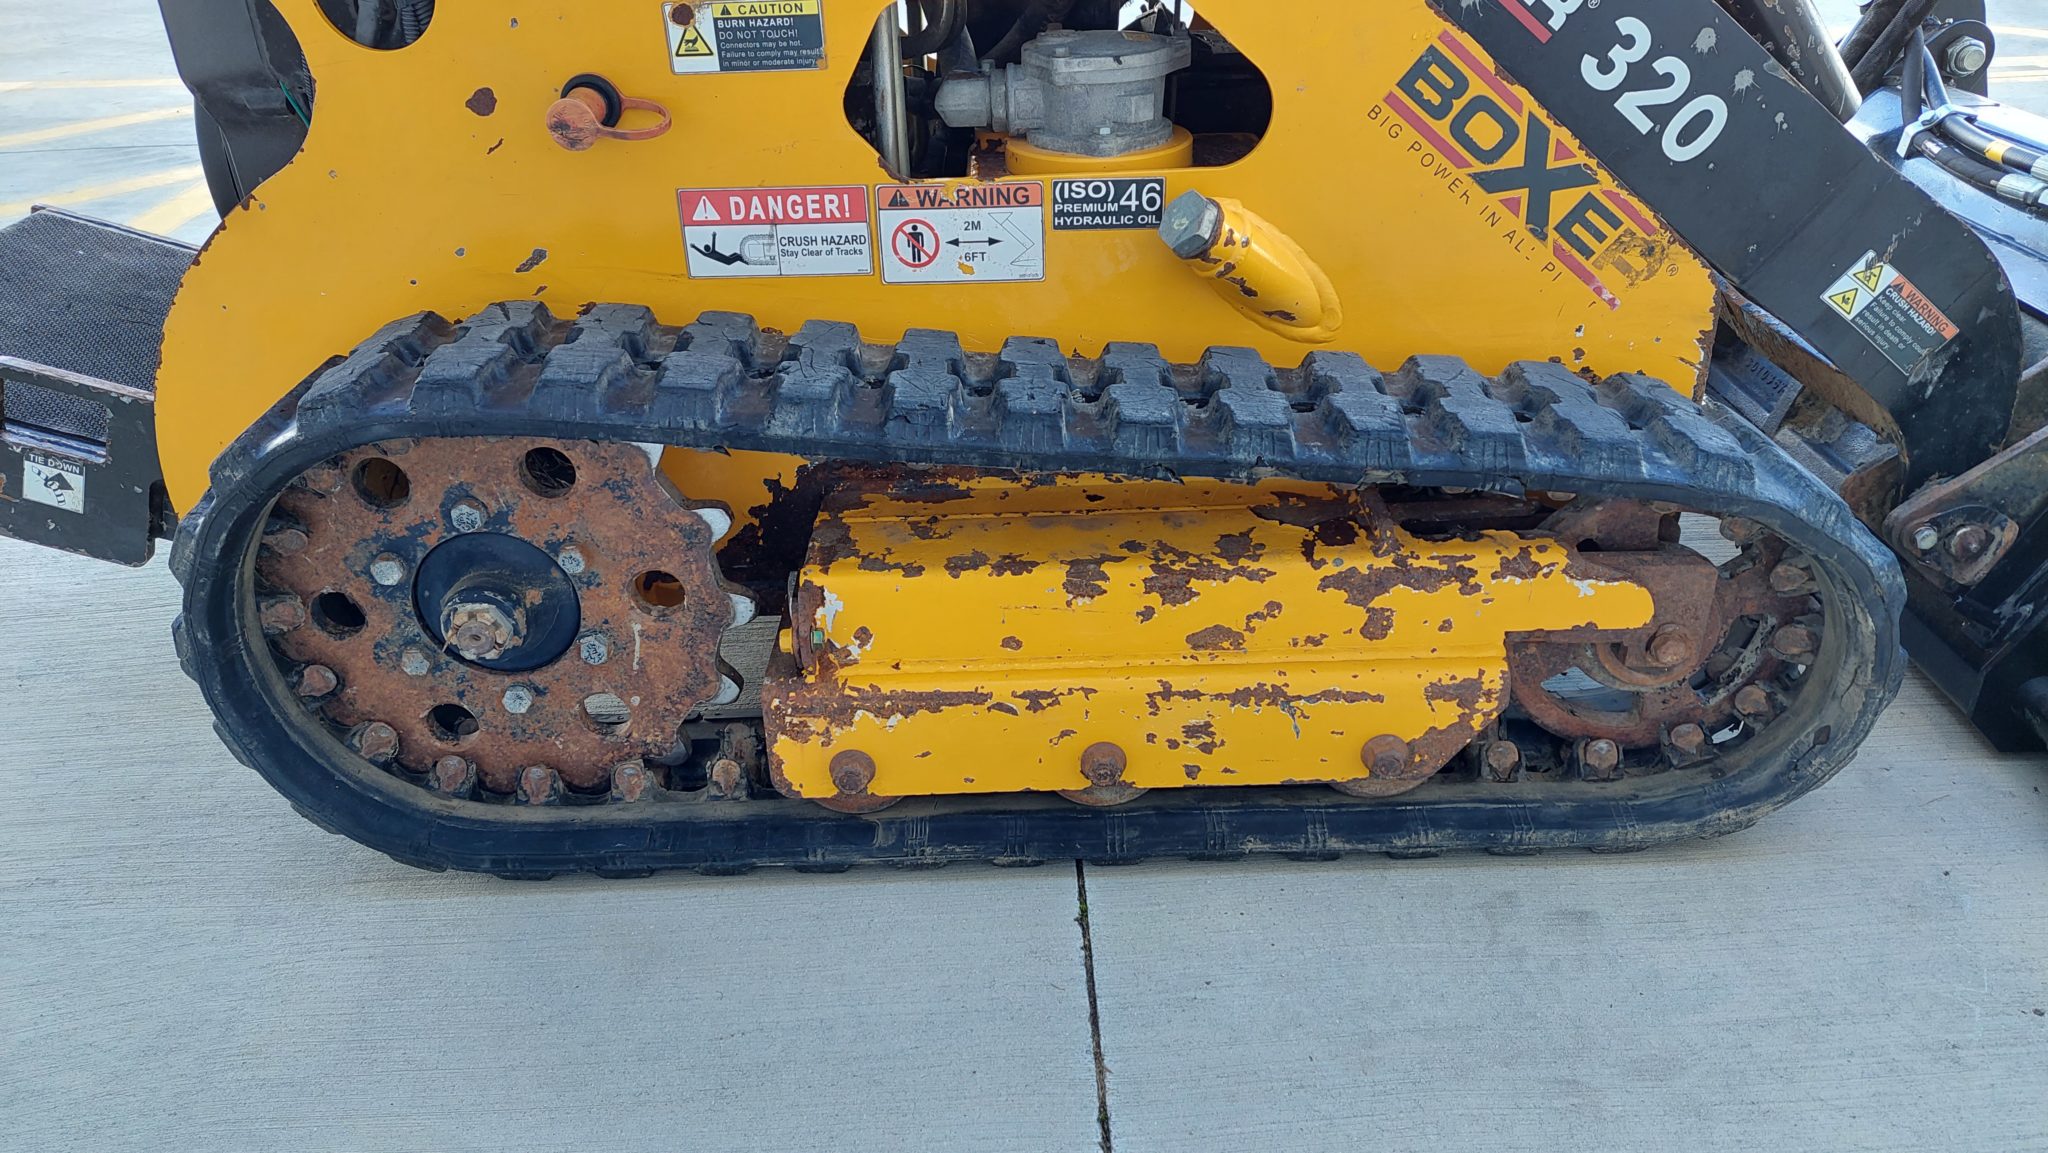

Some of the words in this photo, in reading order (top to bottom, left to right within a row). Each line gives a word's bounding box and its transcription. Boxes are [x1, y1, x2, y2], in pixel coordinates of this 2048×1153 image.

[737, 3, 804, 15] CAUTION
[717, 19, 746, 29] BURN
[749, 17, 794, 27] HAZARD!
[719, 31, 734, 40] DO
[736, 30, 757, 39] NOT
[760, 29, 798, 39] TOUCH!
[720, 41, 760, 49] Connectors
[721, 50, 746, 58] Failure
[756, 50, 781, 58] comply
[761, 58, 795, 66] moderate
[1580, 16, 1729, 162] 320
[1367, 104, 1403, 139] BIG
[1479, 205, 1502, 228] IN
[1054, 181, 1115, 203] (ISO)
[1119, 182, 1161, 212] 46
[728, 193, 850, 221] DANGER!
[1054, 202, 1119, 213] PREMIUM
[963, 220, 982, 231] 2M
[1054, 215, 1134, 226] HYDRAULIC
[1137, 214, 1160, 224] OIL
[779, 235, 818, 247] CRUSH
[820, 234, 867, 246] HAZARD
[780, 248, 799, 259] Stay
[801, 248, 823, 257] Clear
[825, 247, 834, 256] of
[835, 247, 864, 256] Tracks
[964, 251, 987, 263] 6FT
[1877, 295, 1893, 312] Keep
[1892, 309, 1906, 325] clear.
[1885, 288, 1909, 312] CRUSH
[1907, 309, 1937, 336] HAZARD!
[1905, 290, 1949, 334] WARNING
[1869, 301, 1890, 322] Failure
[1889, 319, 1897, 327] to
[1894, 325, 1914, 344] comply
[1854, 316, 1874, 336] serious
[1874, 333, 1891, 351] injury.
[1861, 309, 1880, 327] result
[1878, 324, 1885, 332] in
[1884, 328, 1900, 345] death
[1898, 342, 1906, 350] or
[29, 453, 45, 465] TIE
